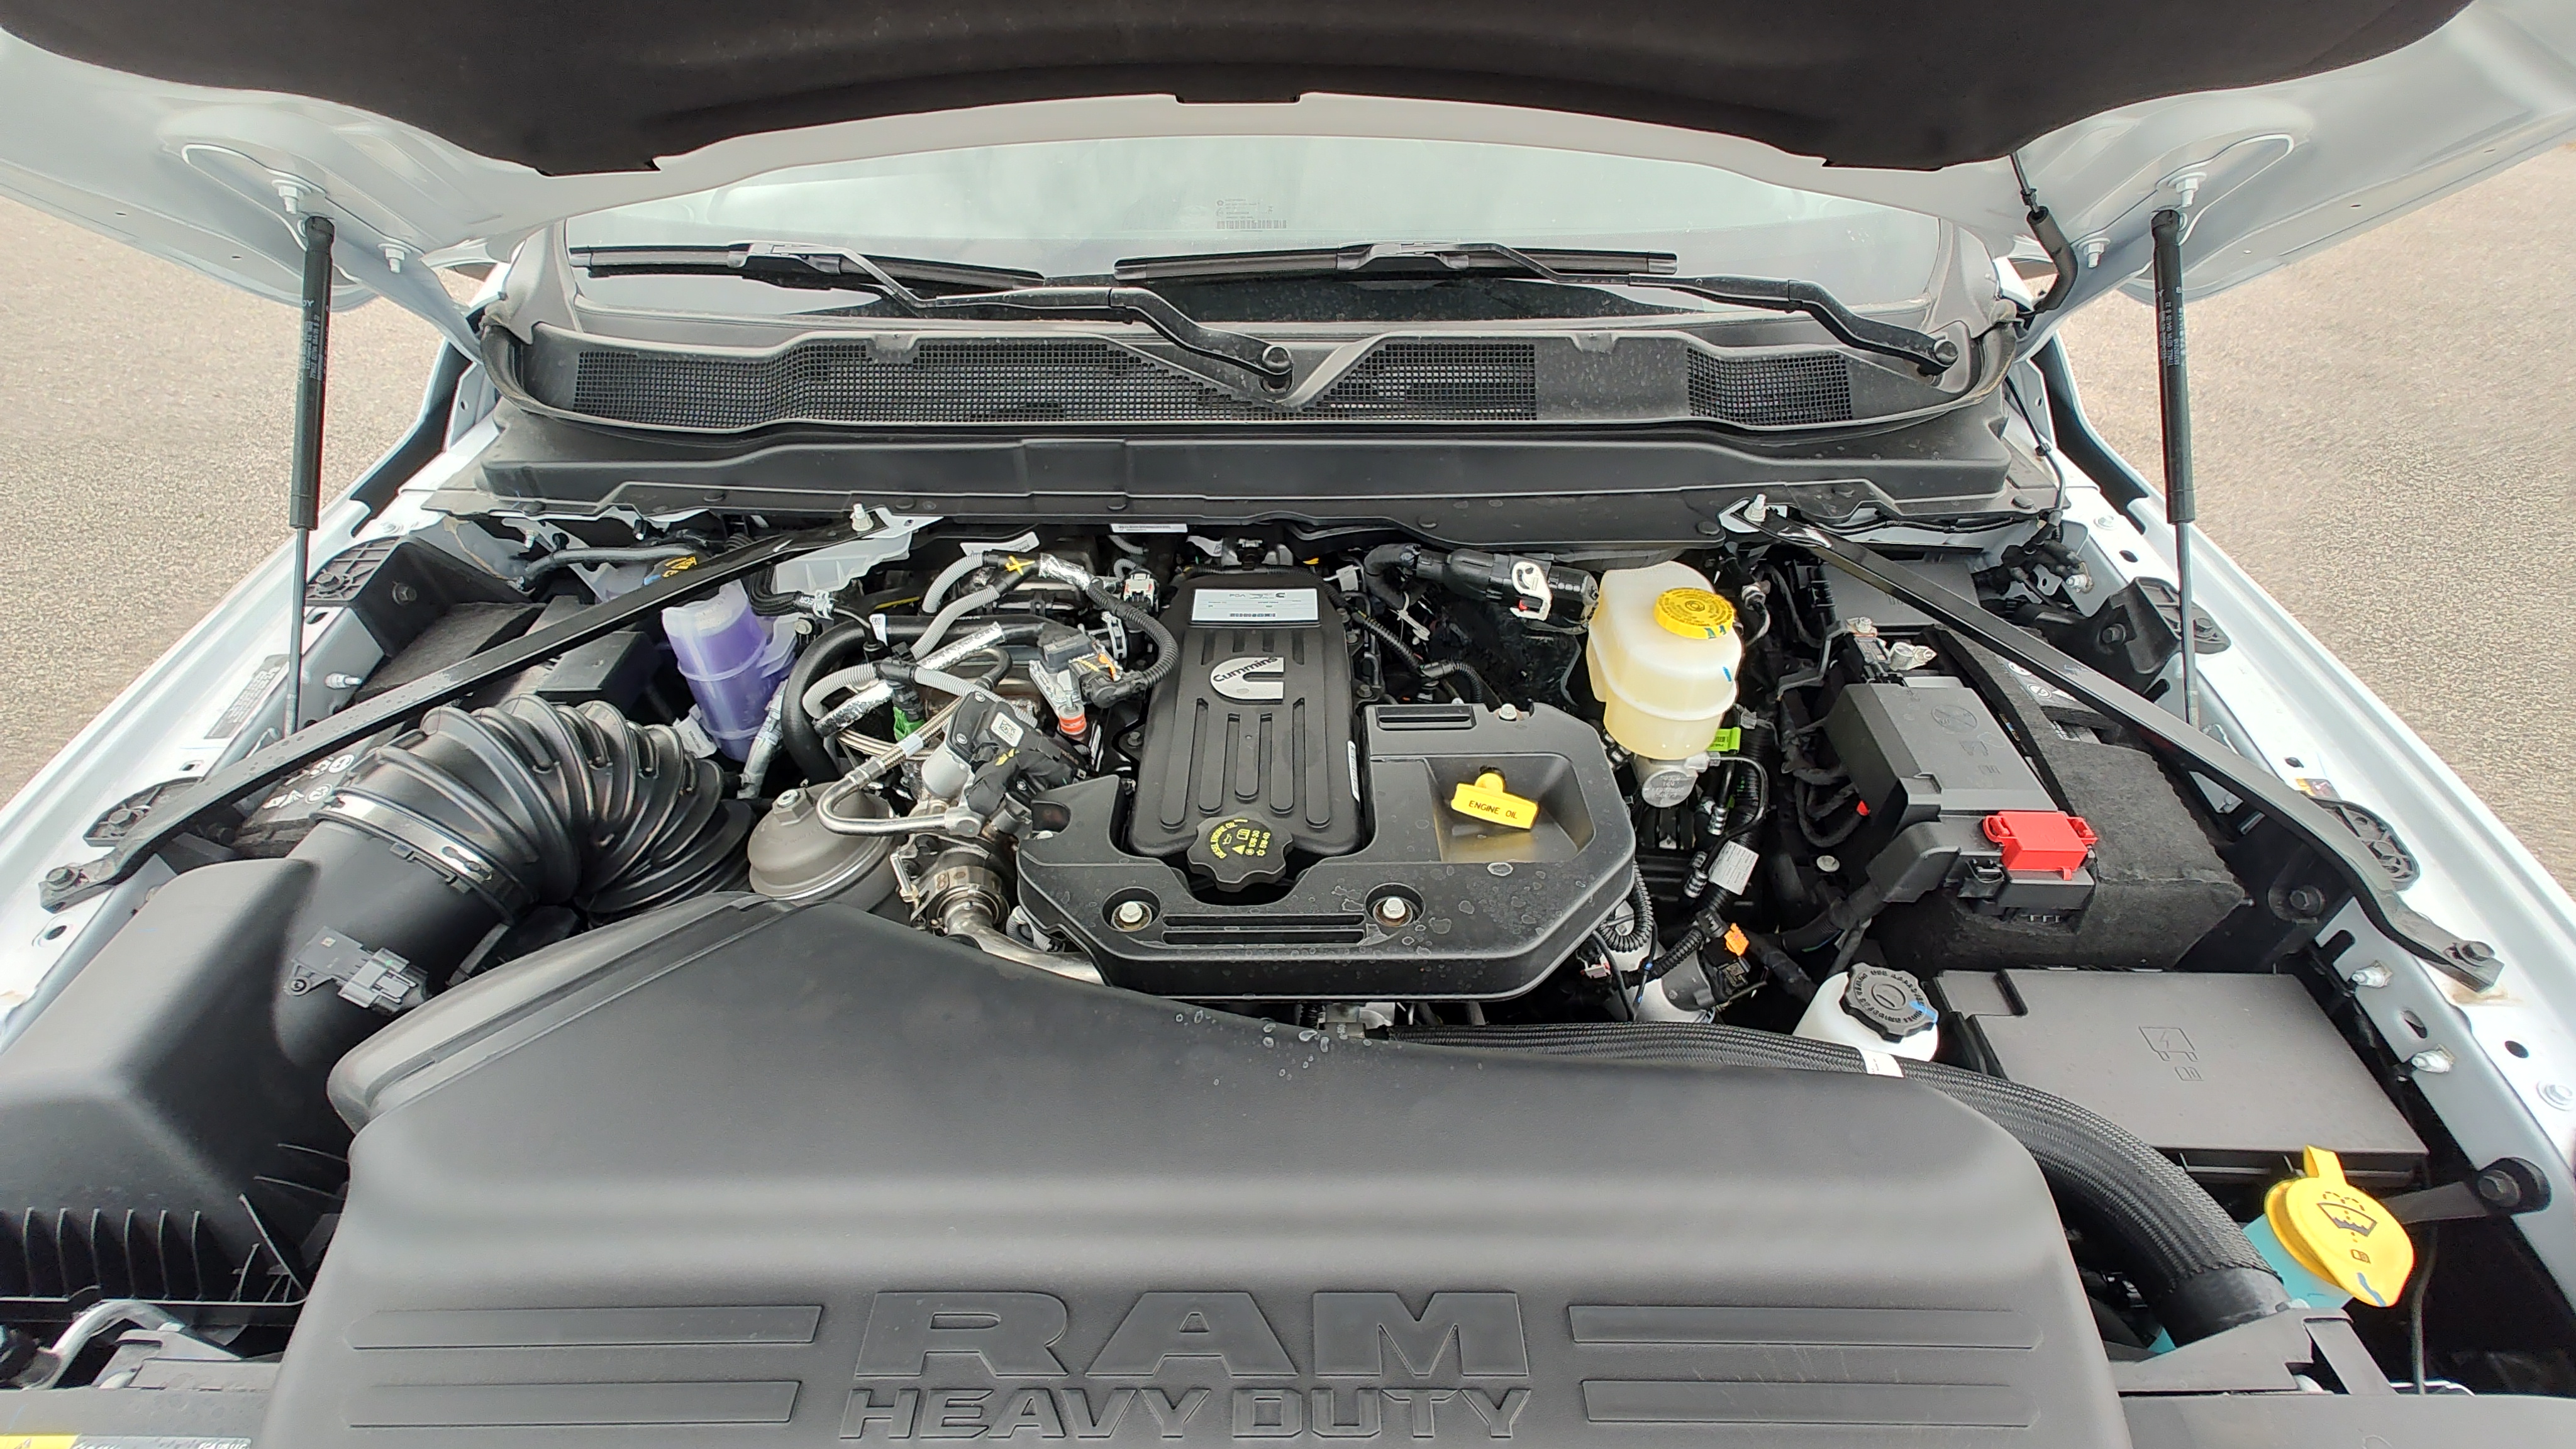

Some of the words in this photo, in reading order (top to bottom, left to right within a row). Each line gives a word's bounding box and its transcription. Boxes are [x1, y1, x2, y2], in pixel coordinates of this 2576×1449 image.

[1213, 658, 1278, 682] Cummins
[1468, 800, 1501, 815] ENGINE
[1505, 810, 1518, 819] OIL
[1210, 826, 1228, 843] ENGINE
[1225, 821, 1238, 830] OIL
[1210, 843, 1228, 859] DIESEL
[853, 1290, 1531, 1379] RAM
[838, 1387, 1212, 1440] HEAVY
[1230, 1387, 1533, 1440] DUTY
